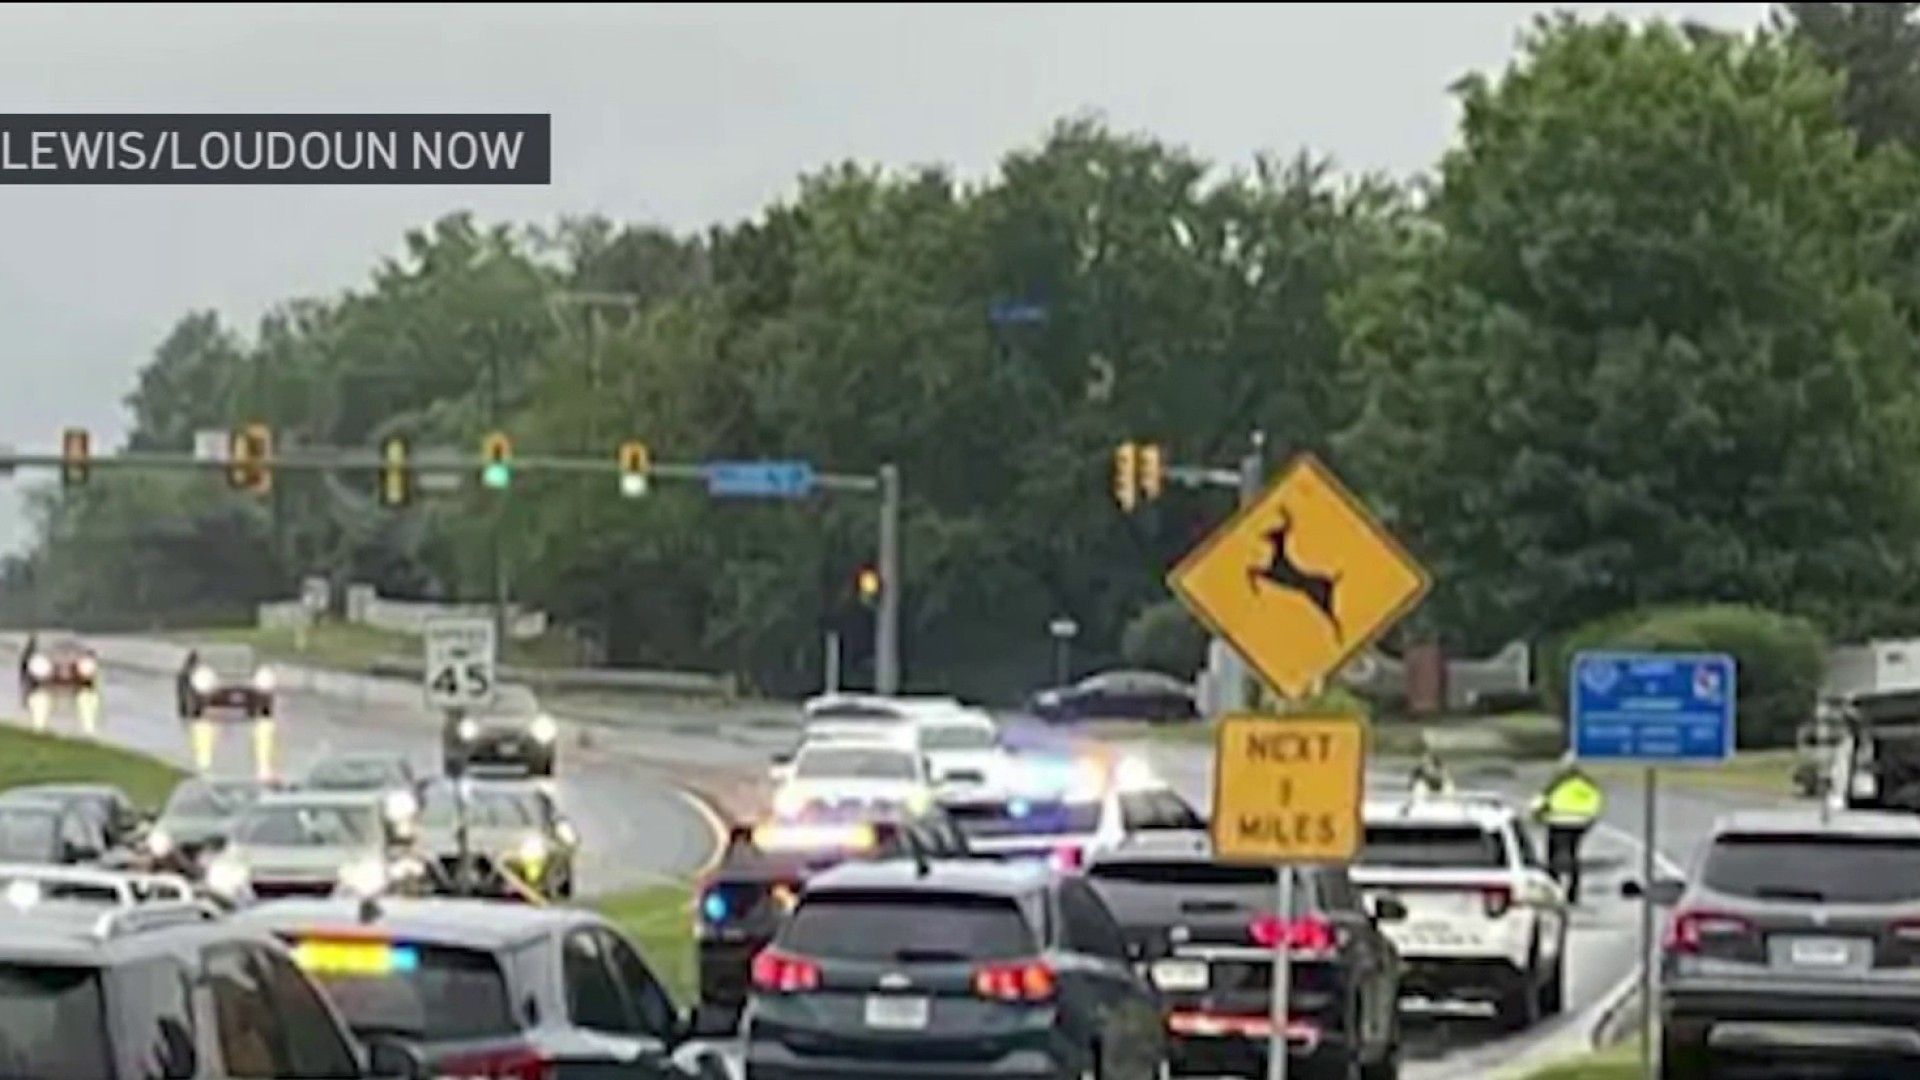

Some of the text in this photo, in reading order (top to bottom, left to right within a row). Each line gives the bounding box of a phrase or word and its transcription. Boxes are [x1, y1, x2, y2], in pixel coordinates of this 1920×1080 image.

[432, 664, 489, 698] 45
[1246, 733, 1332, 763] NEXT
[1239, 813, 1336, 845] MILES
